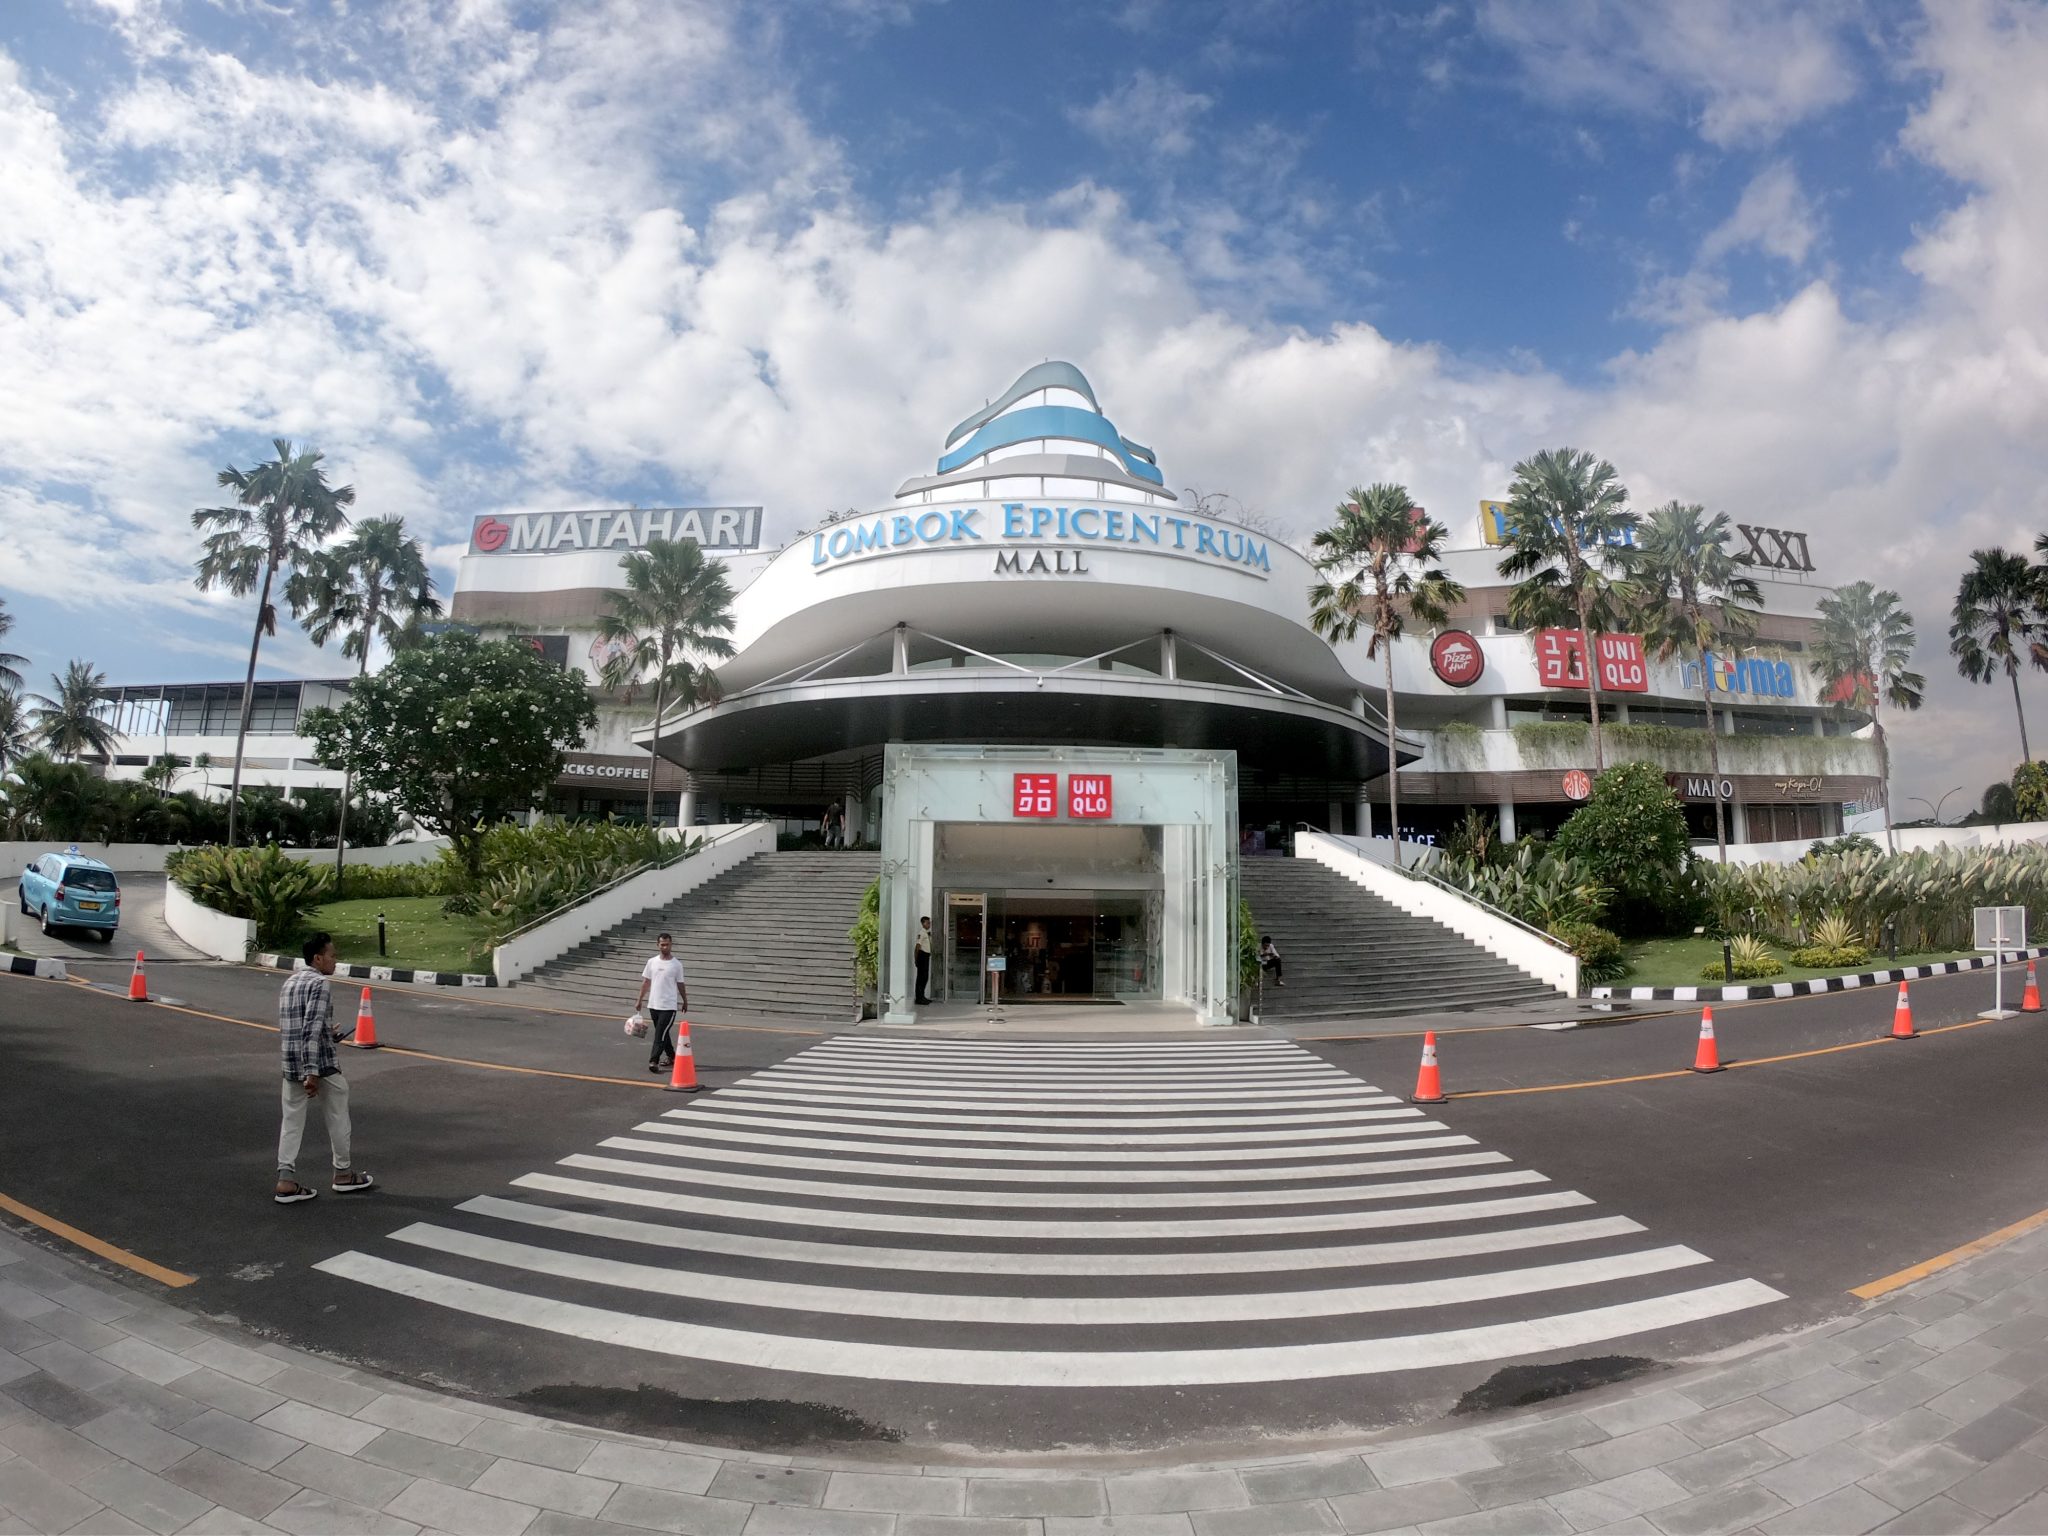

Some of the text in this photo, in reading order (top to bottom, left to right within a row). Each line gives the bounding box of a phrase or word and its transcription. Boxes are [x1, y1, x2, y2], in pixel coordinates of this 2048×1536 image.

[510, 509, 762, 550] MATAHARI
[812, 503, 1271, 572] LOMBOK EPICENTRUM
[1736, 524, 1816, 571] XXI
[993, 550, 1088, 574] MALL
[1602, 640, 1636, 661] UNI
[1443, 653, 1473, 668] Pizza
[1448, 660, 1470, 673] Hut
[1606, 664, 1642, 686] QLO
[596, 766, 649, 779] COFFEE
[1073, 780, 1104, 795] UNI
[1073, 797, 1107, 814] QLO
[1375, 834, 1435, 847] ACE
